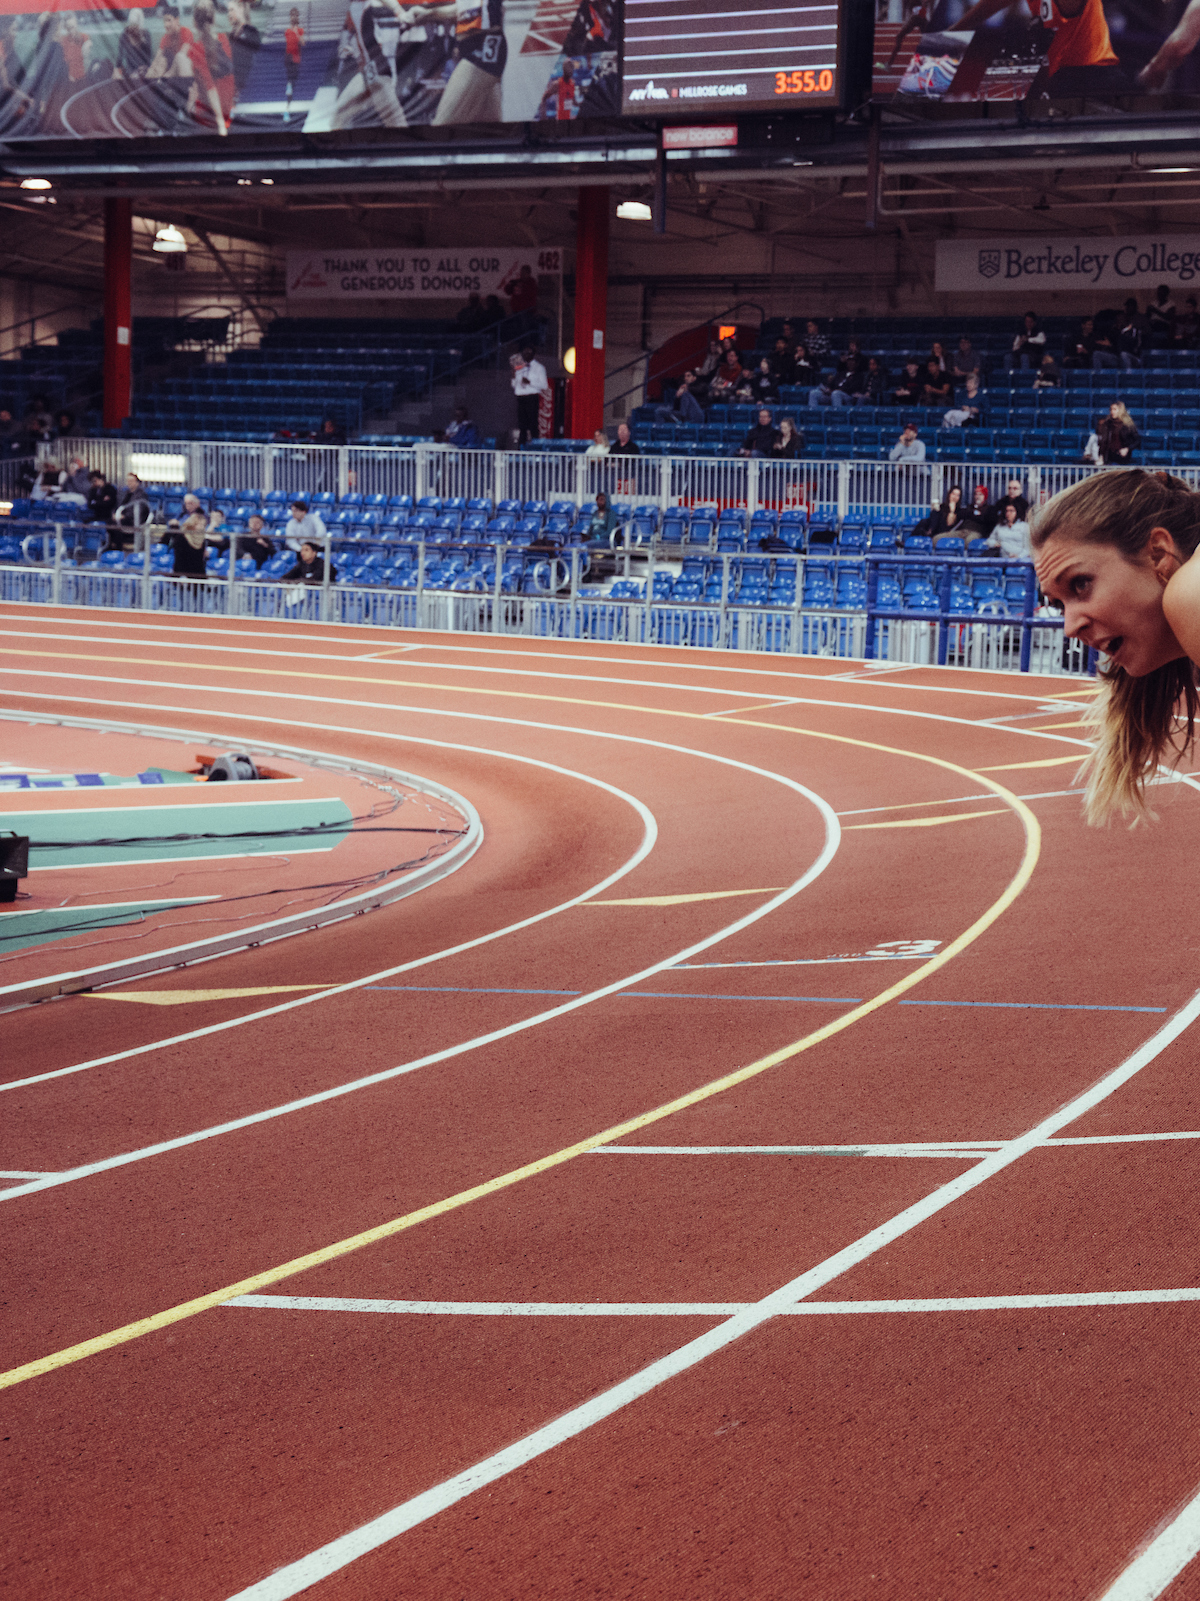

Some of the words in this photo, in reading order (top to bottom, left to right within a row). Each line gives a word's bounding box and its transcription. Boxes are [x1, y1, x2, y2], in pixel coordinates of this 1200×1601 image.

[679, 85, 718, 98] MILLROSE
[718, 83, 748, 96] GAMES
[773, 69, 834, 94] 3:55.0
[665, 131, 688, 143] new
[689, 128, 734, 142] balance
[323, 258, 367, 272] THANK
[376, 258, 405, 272] YOU
[410, 258, 431, 272] TO
[437, 258, 462, 272] ALL
[469, 258, 500, 272] OUR
[538, 251, 560, 270] 462
[1004, 246, 1109, 282] Berkeley
[340, 276, 415, 291] GENEROUS
[421, 276, 481, 291] DONORS
[864, 939, 943, 956] 3
